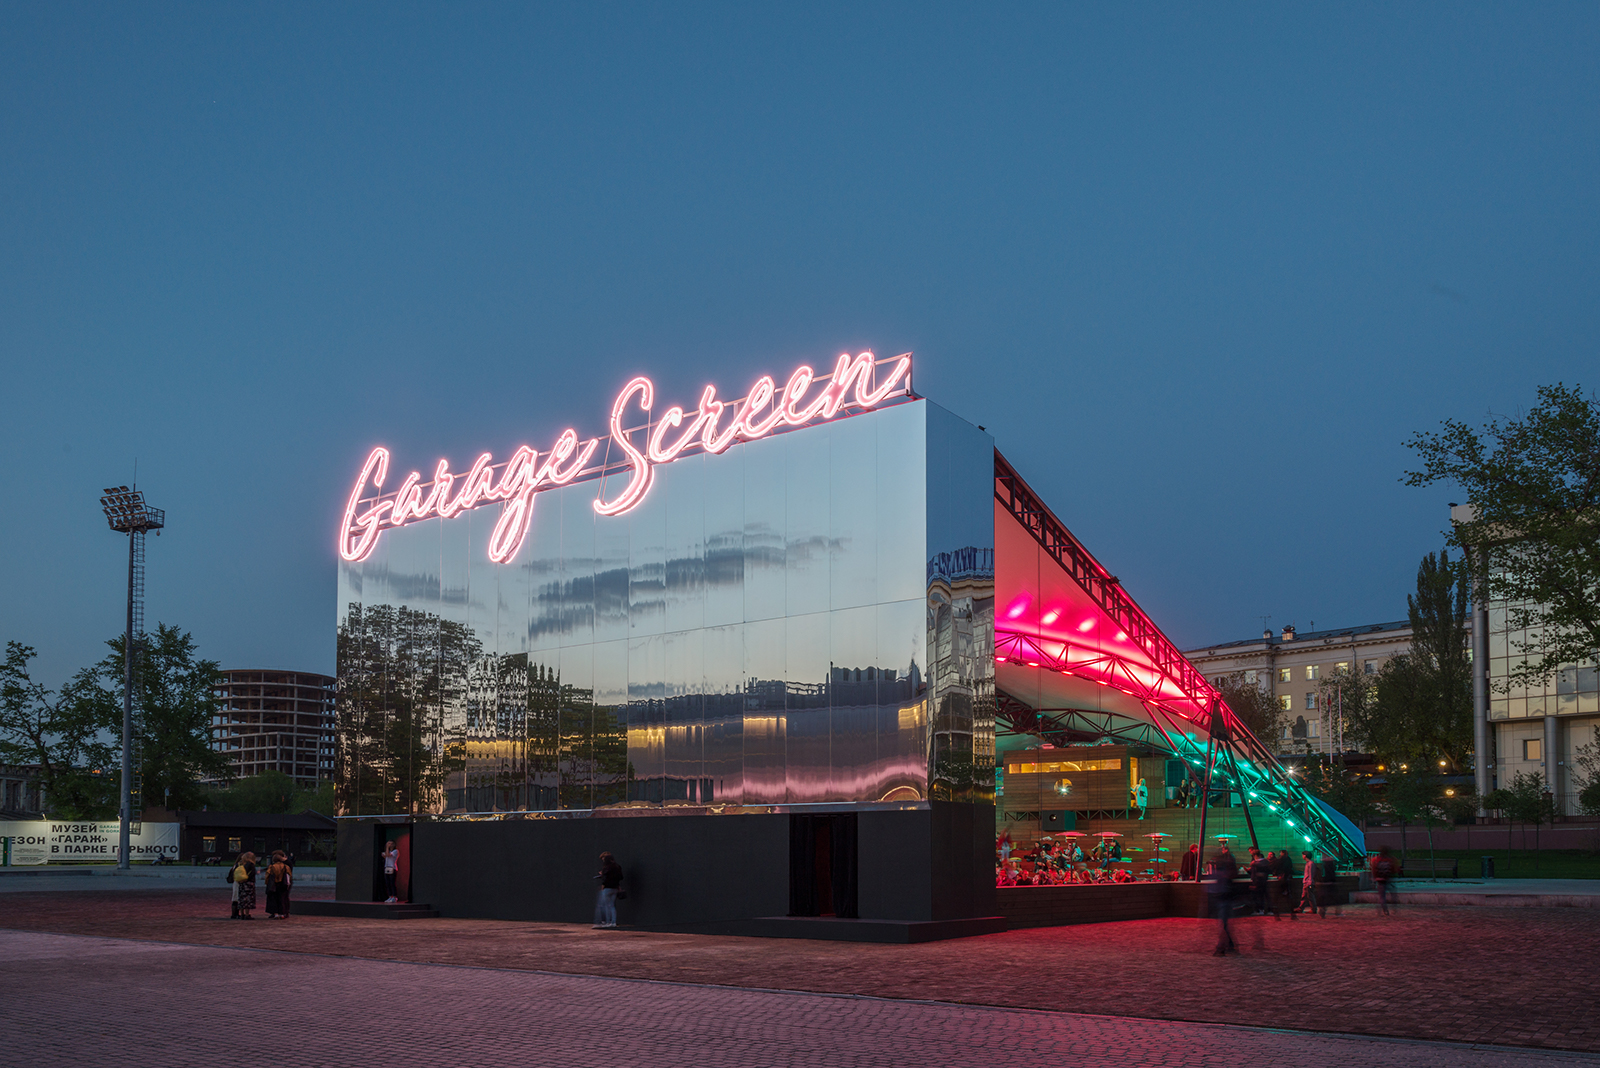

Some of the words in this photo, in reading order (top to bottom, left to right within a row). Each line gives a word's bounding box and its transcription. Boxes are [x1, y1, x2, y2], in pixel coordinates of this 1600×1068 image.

[338, 429, 598, 564] Garage
[593, 351, 910, 517] Screen
[51, 822, 97, 833] МУЗЕЙ
[51, 835, 108, 843] «ГАРАЖ»
[51, 845, 60, 853] В
[64, 845, 107, 853] ПАРКЕ
[112, 845, 179, 853] ГРЬКОГО
